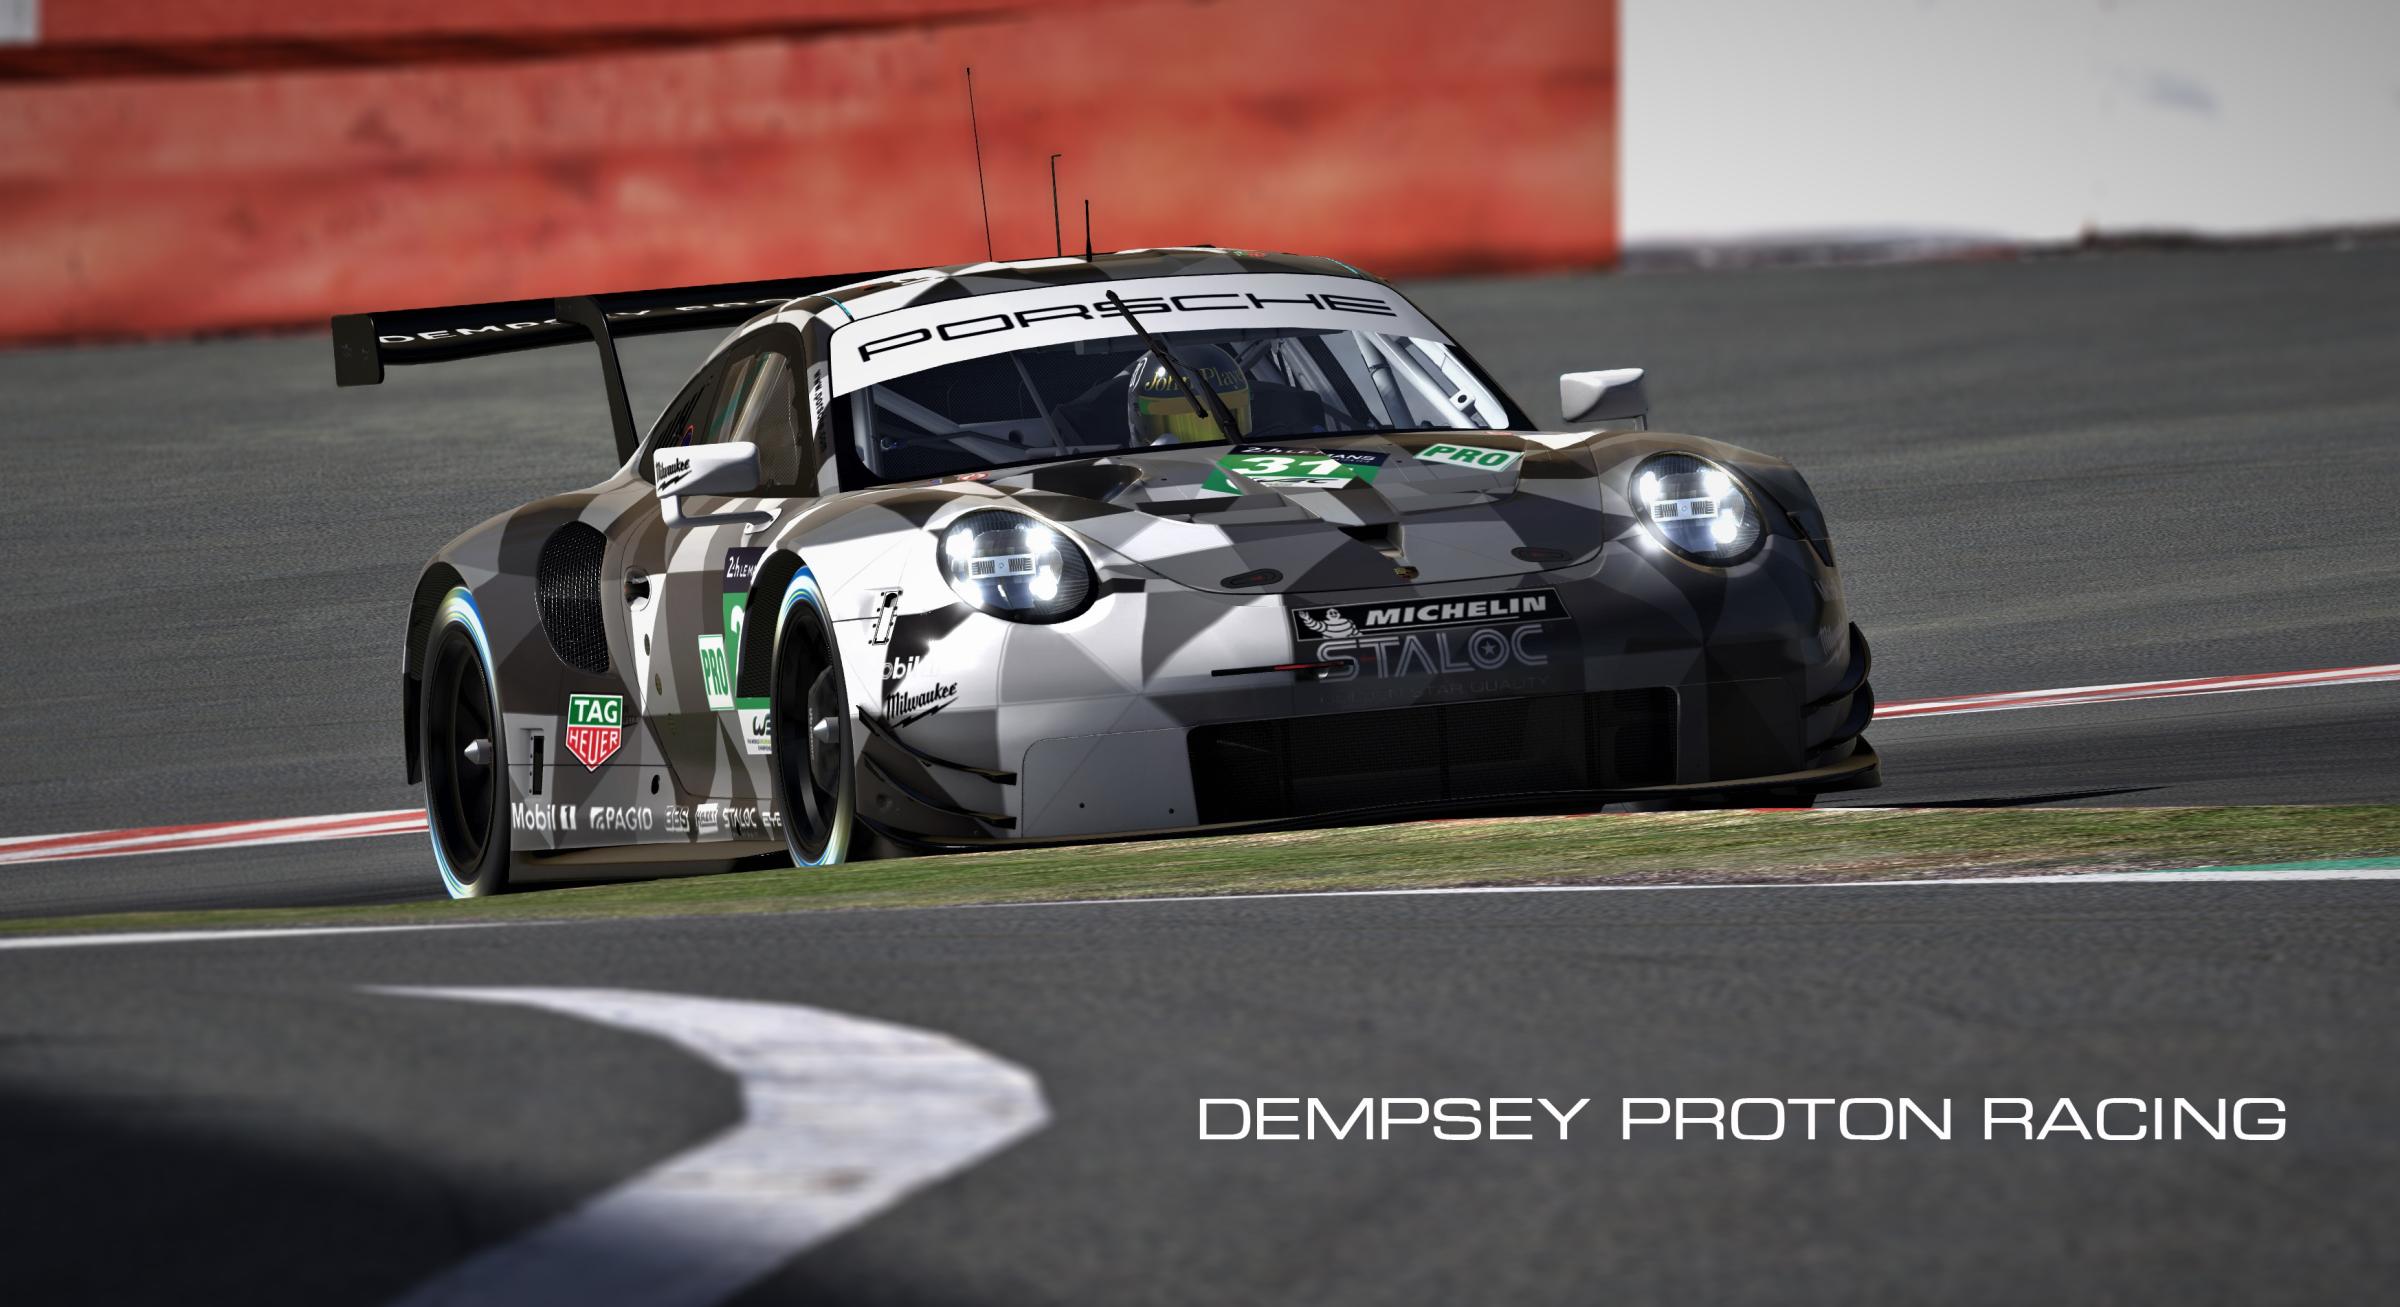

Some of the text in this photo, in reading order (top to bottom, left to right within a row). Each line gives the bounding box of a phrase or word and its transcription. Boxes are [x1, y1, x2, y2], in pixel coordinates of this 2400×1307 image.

[858, 293, 1397, 362] PORSCHE
[1231, 456, 1342, 475] 31
[1423, 445, 1511, 467] PRO
[1365, 596, 1546, 626] MICHELIN
[1316, 623, 1548, 684] STALOC
[701, 647, 729, 696] PRO
[574, 699, 618, 723] TAG
[886, 682, 958, 720] Milwaukee
[569, 729, 618, 765] HEUER
[511, 802, 557, 831] Mobil
[606, 807, 653, 831] PAGID
[722, 807, 758, 829] STALOC
